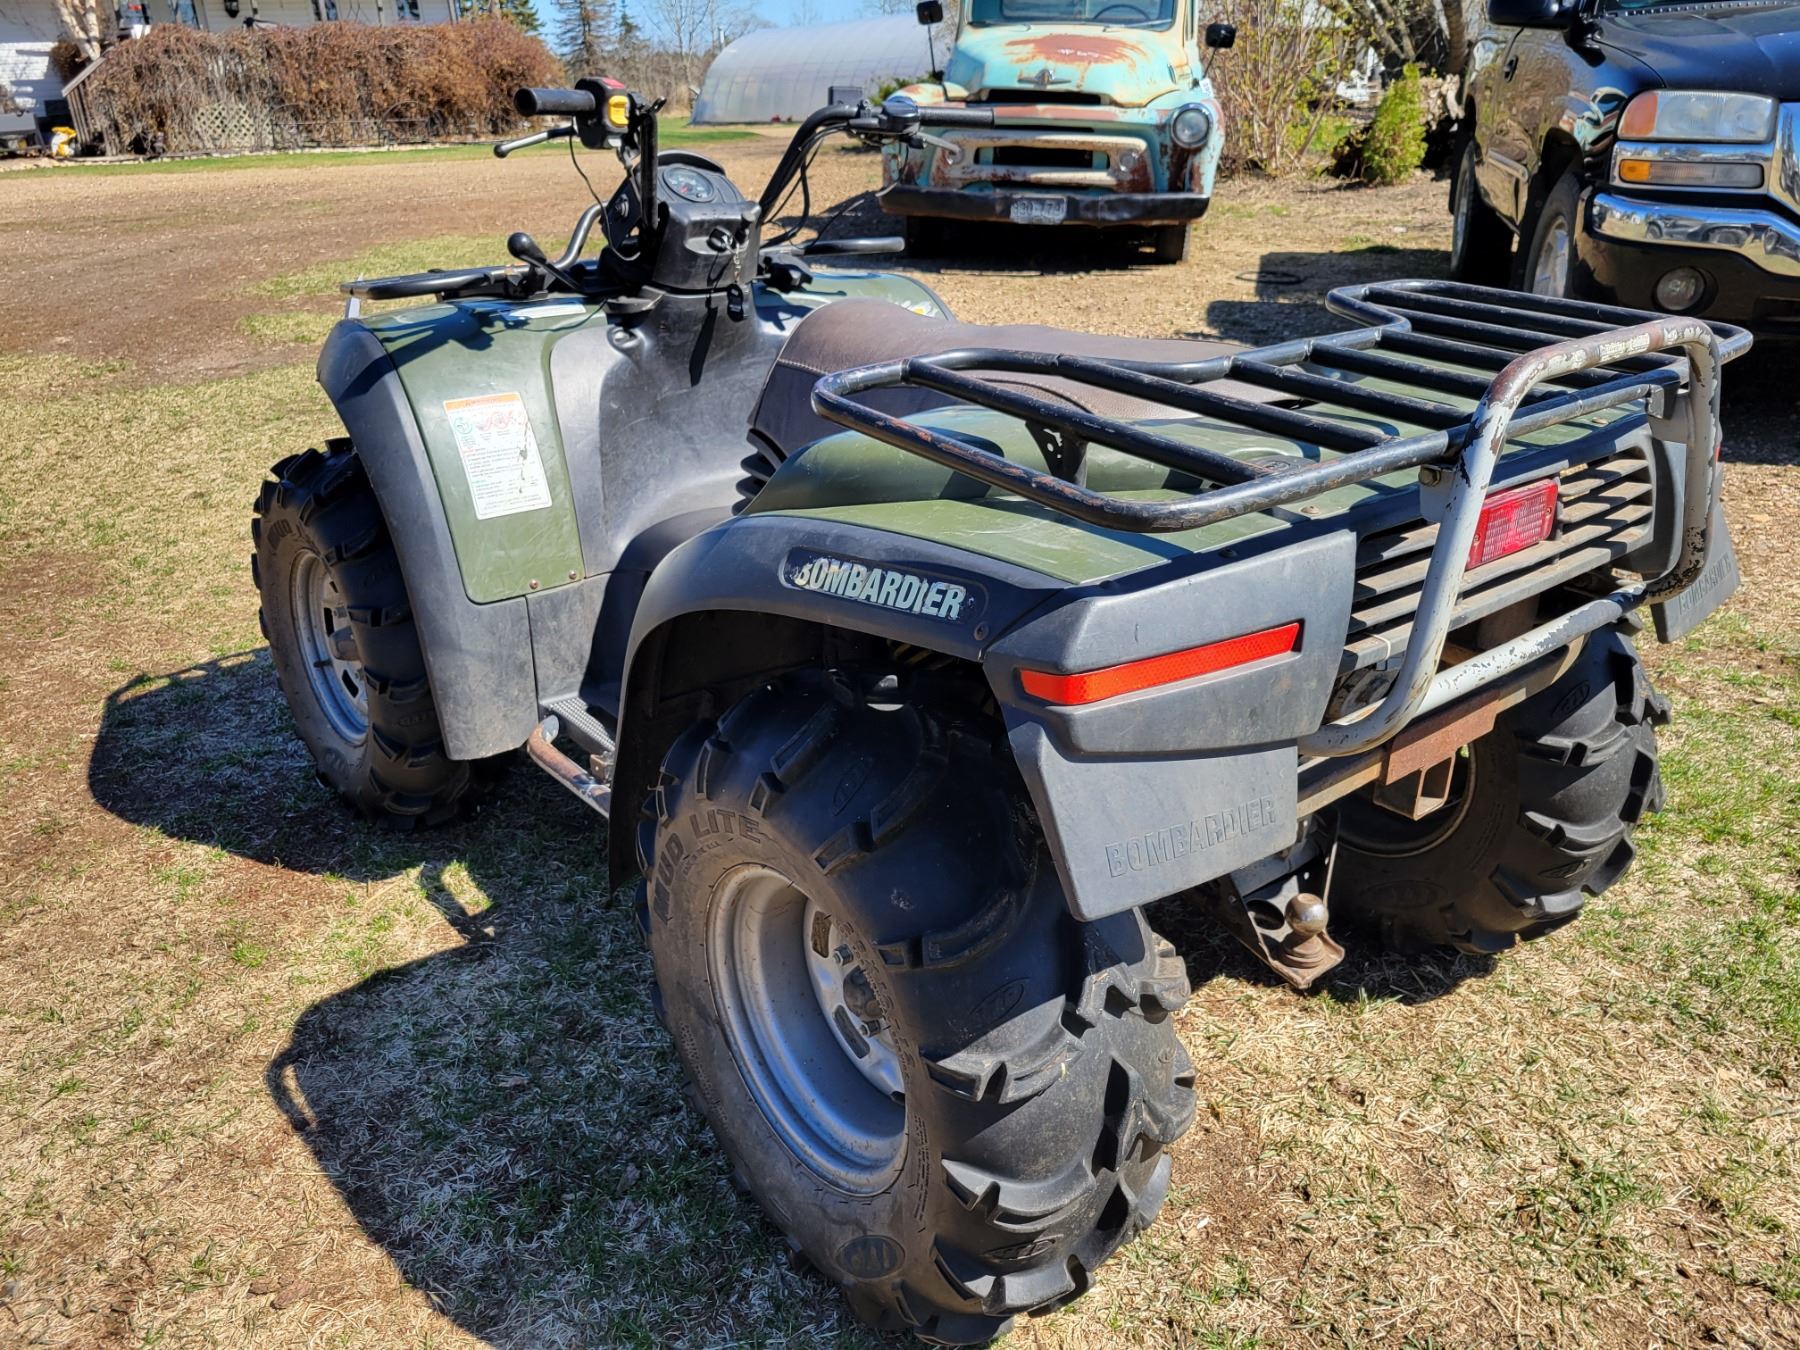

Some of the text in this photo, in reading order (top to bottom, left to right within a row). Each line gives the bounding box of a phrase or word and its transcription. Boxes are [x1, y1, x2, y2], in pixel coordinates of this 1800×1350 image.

[794, 557, 966, 620] BOMBARDIER
[653, 832, 684, 925] MUD
[689, 809, 761, 844] LITE
[1105, 796, 1276, 877] BOMBARDIER
